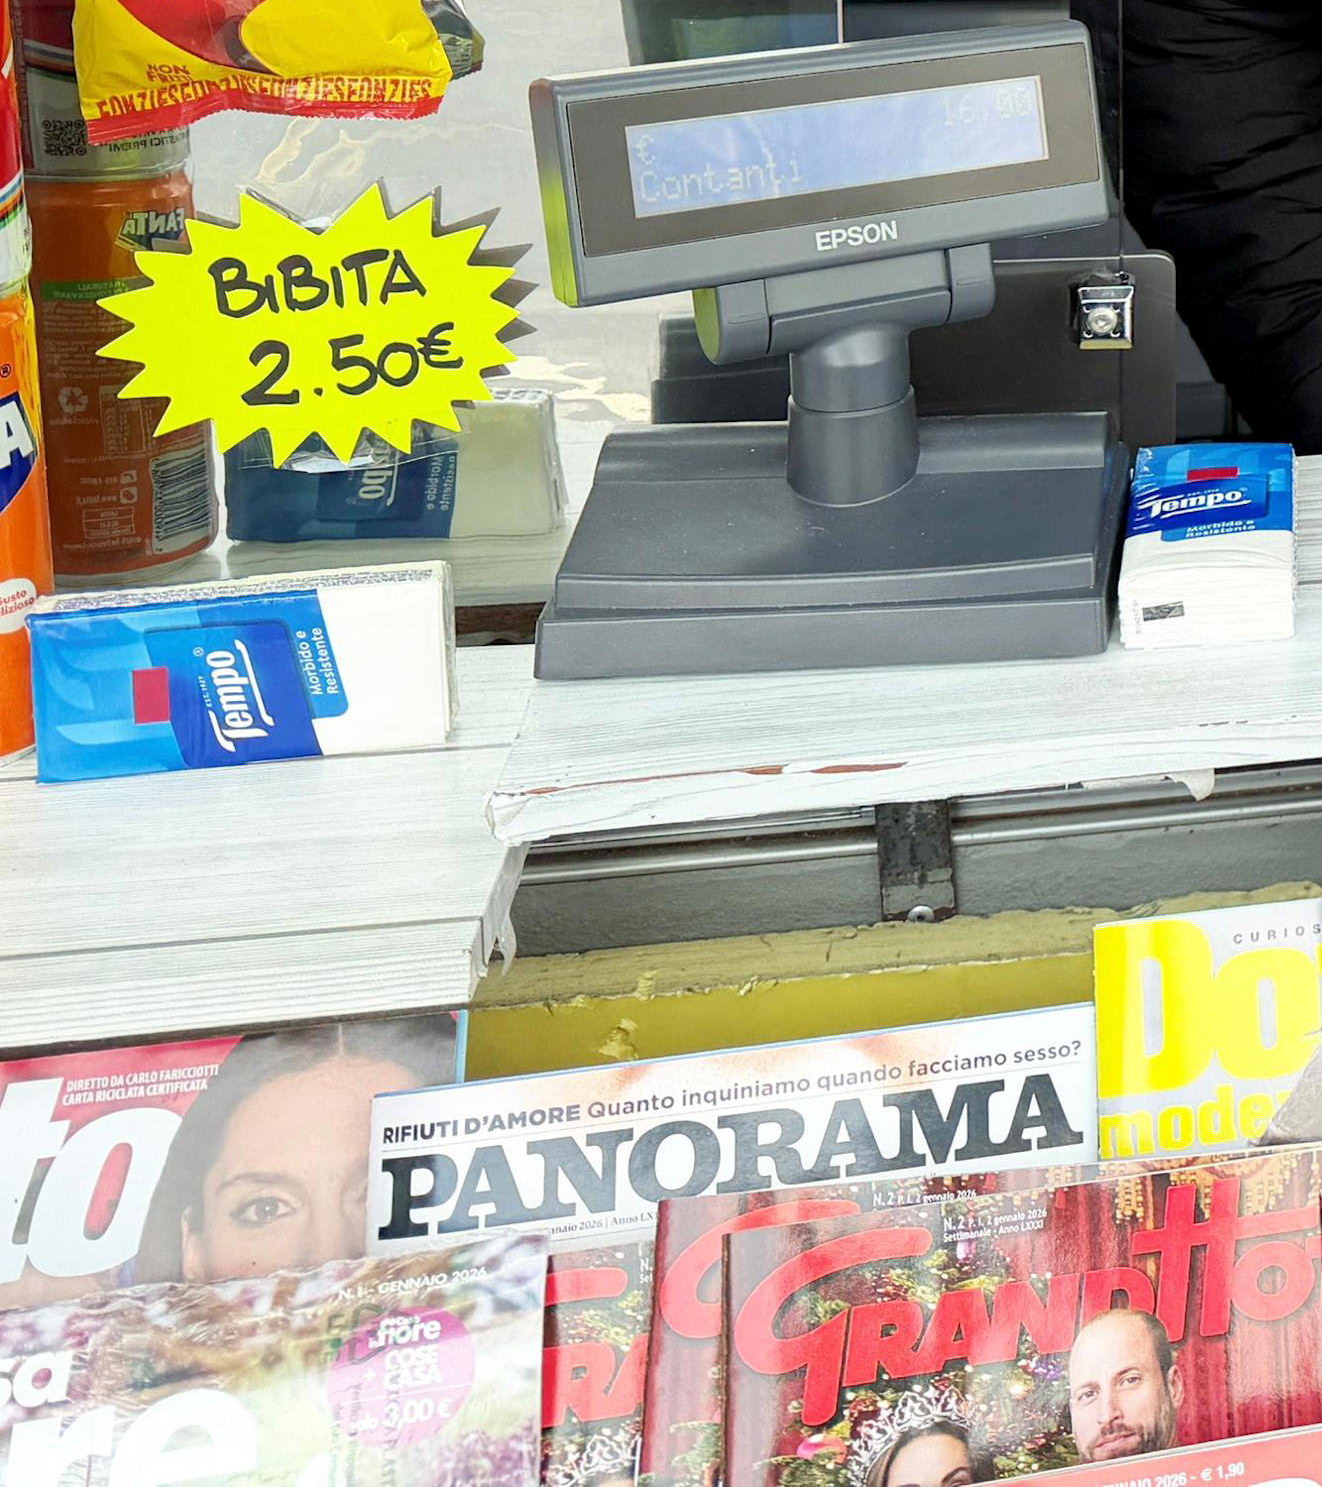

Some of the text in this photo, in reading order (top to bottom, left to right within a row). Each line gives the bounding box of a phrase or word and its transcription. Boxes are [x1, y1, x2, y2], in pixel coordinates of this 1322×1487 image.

[639, 153, 800, 203] Contanti
[816, 221, 897, 252] EPSON
[208, 248, 427, 317] BIBITA
[242, 323, 463, 407] 2.50€
[1148, 488, 1245, 518] Tempo
[311, 628, 338, 694] Resistente
[207, 649, 255, 753] Tempo
[62, 1080, 208, 1105] CARTA RICICLATA CERTIFICATA
[383, 1120, 458, 1145] RIFIUTI
[588, 1092, 674, 1120] Quanto
[682, 1075, 810, 1108] inquiniamo
[818, 1064, 902, 1097] quando
[908, 1050, 1006, 1079] facciamo
[1014, 1040, 1081, 1066] sesso?
[377, 1073, 1083, 1241] PANORAMA
